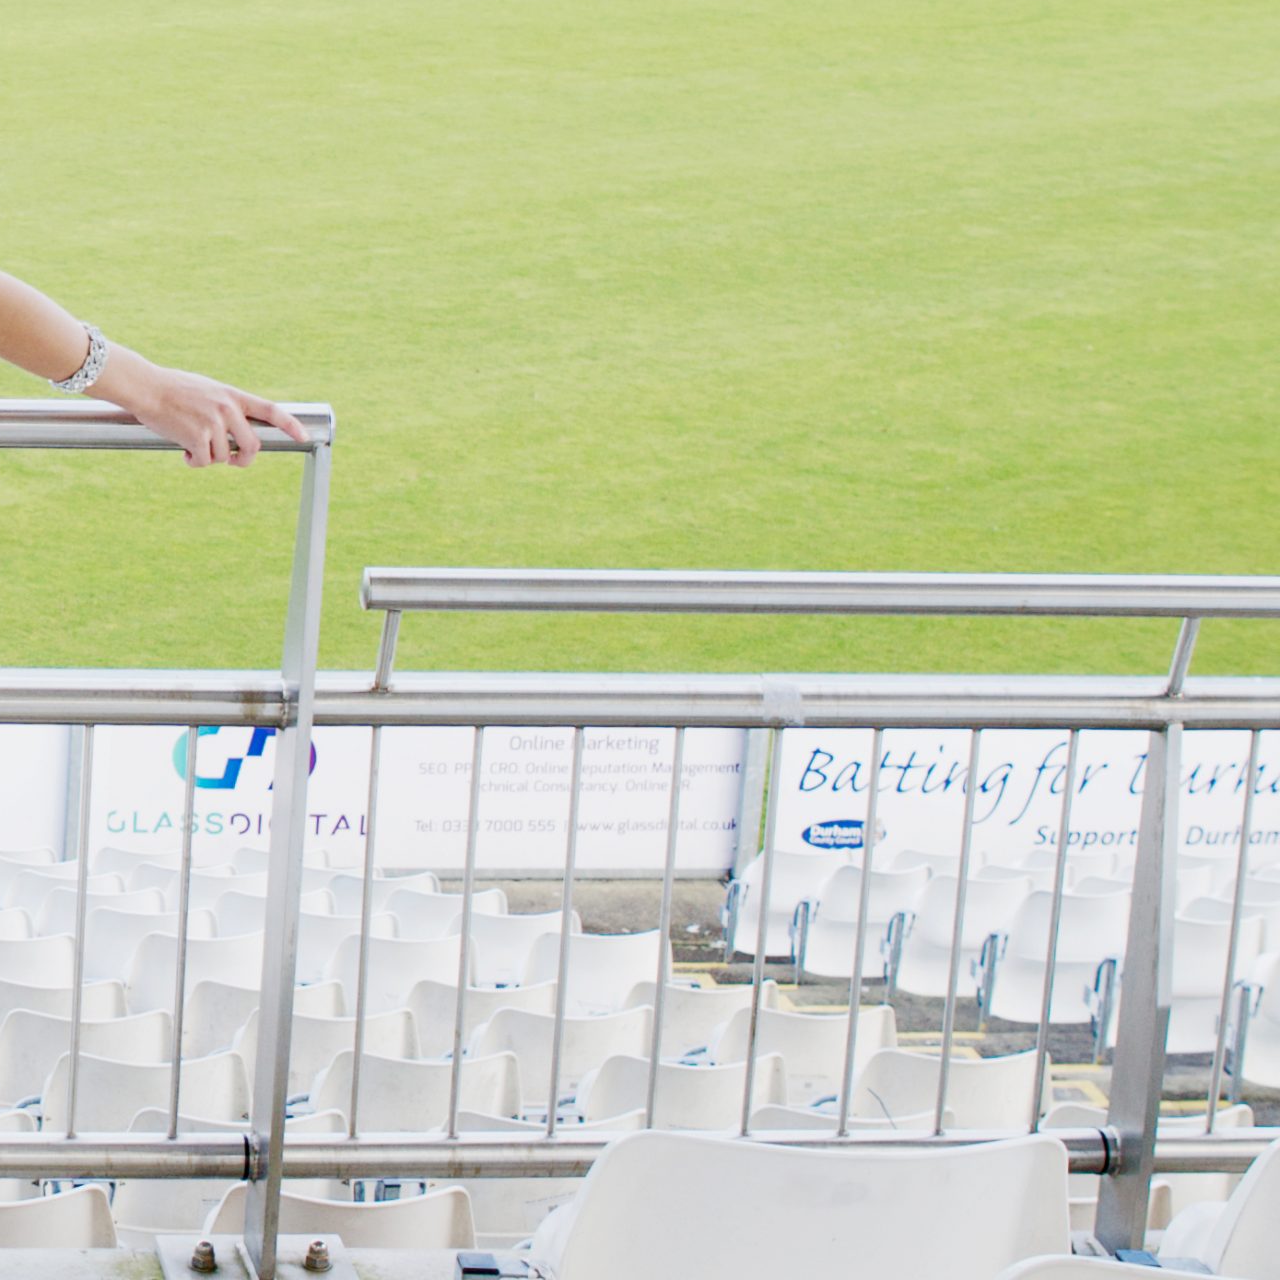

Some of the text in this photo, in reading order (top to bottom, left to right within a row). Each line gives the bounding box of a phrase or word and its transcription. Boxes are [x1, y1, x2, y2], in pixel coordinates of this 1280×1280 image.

[509, 736, 565, 751] Online
[574, 763, 647, 778] eputation
[486, 820, 523, 832] 7000
[528, 820, 556, 832] 555
